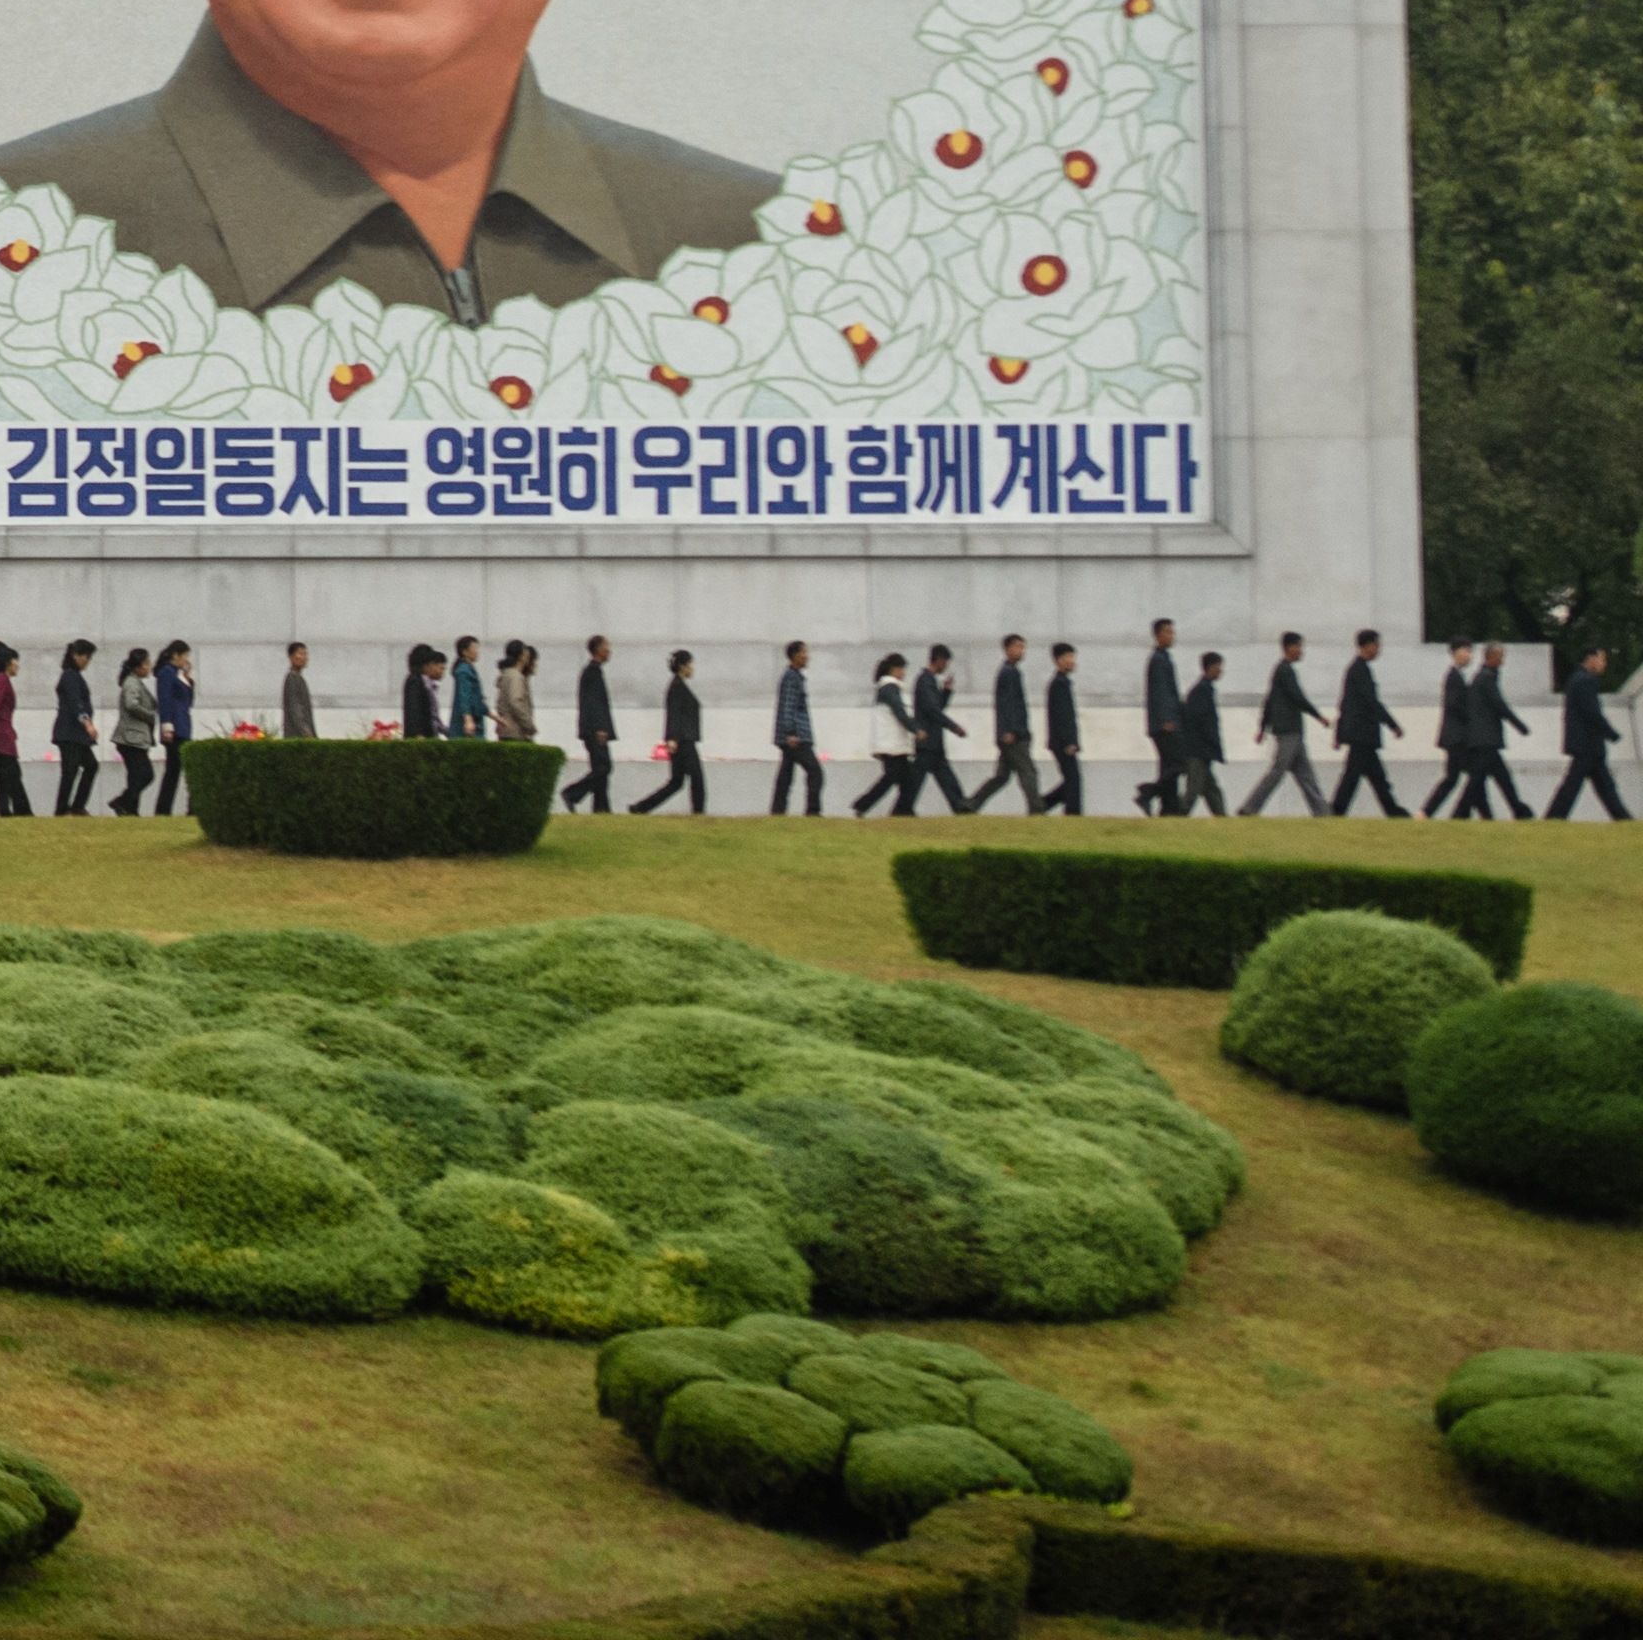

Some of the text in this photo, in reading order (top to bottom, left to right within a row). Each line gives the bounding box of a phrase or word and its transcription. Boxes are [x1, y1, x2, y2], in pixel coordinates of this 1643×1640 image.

[7, 428, 408, 516] 김정일동지는
[425, 427, 619, 515] 영원히
[632, 426, 833, 515] 우리와
[847, 425, 981, 514] 함께
[992, 424, 1199, 513] 계신다
